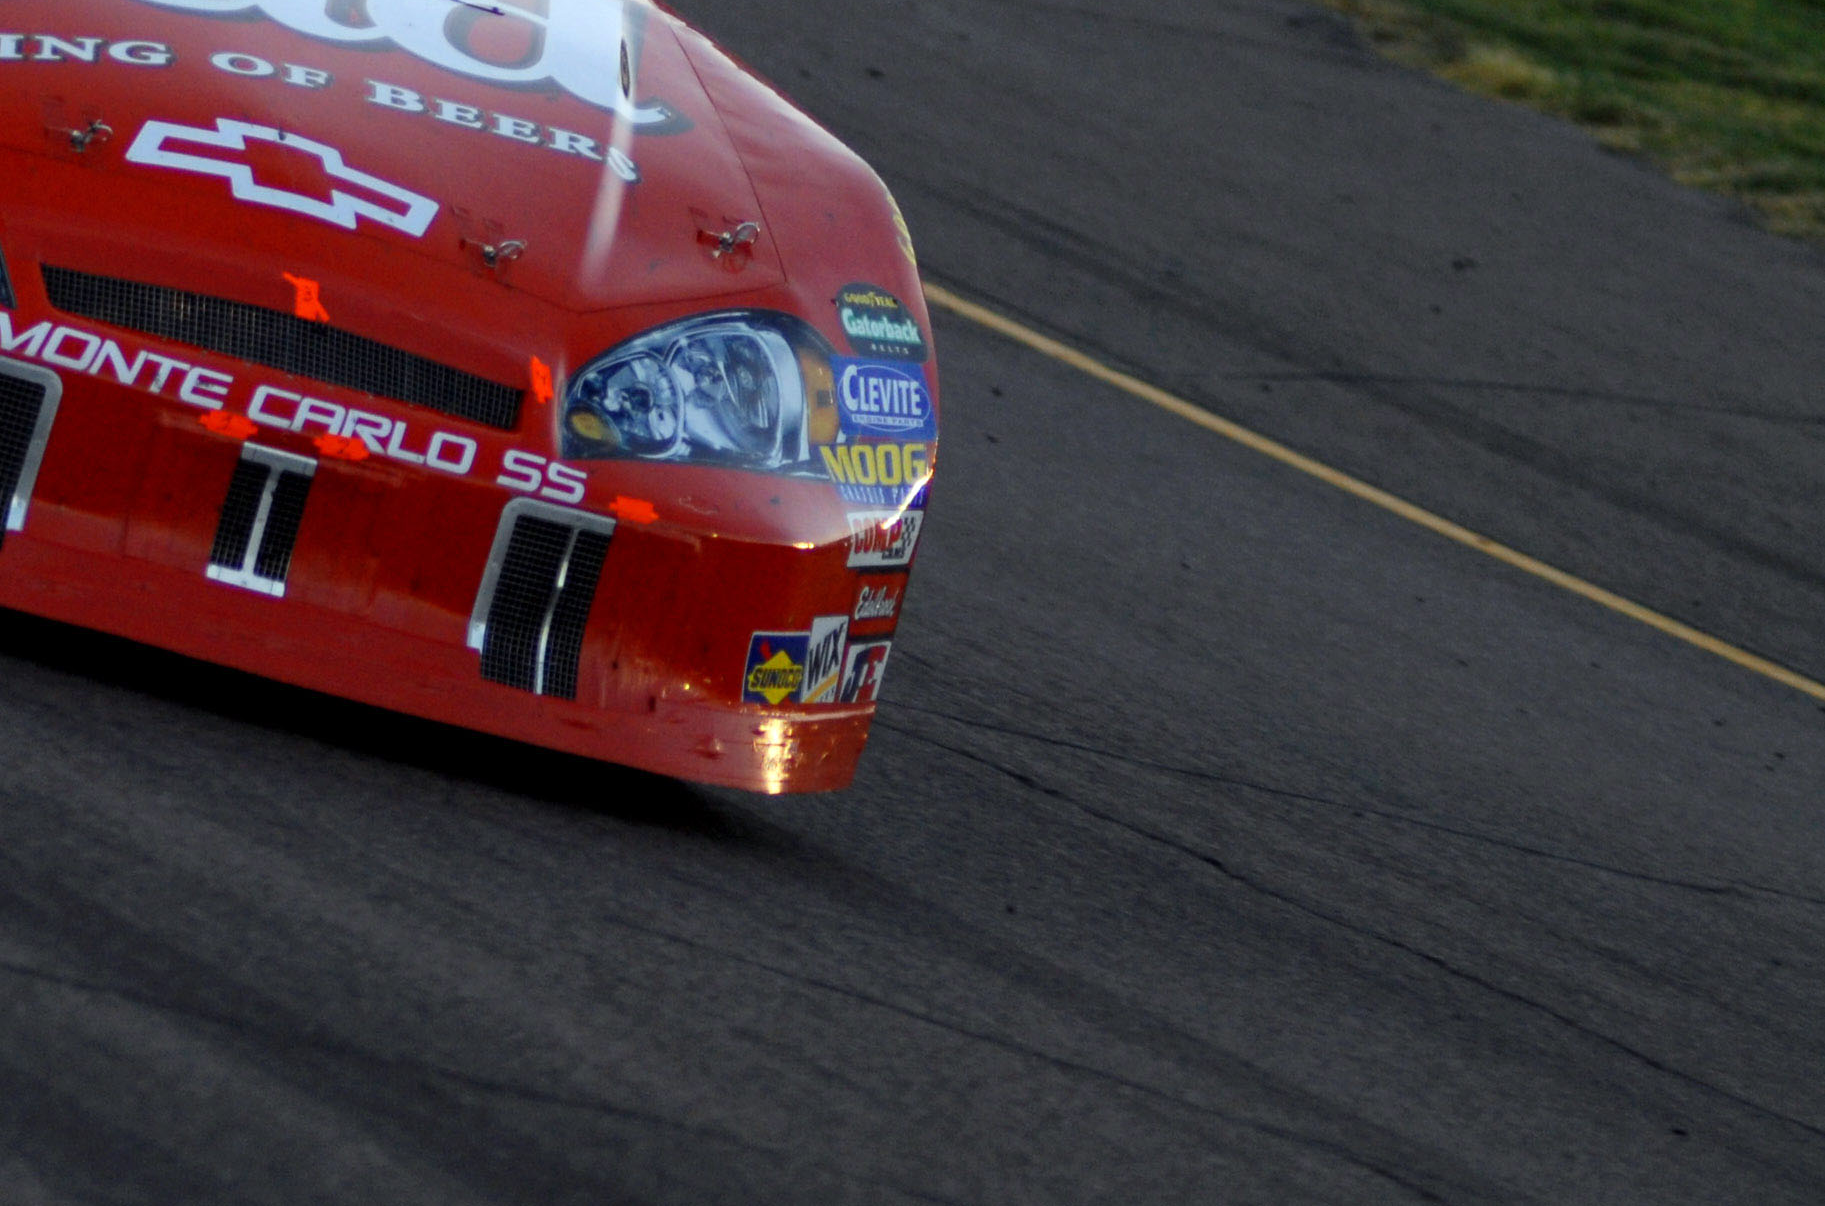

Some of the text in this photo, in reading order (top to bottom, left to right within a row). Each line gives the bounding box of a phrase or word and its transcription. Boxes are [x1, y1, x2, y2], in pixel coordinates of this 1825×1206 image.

[208, 51, 334, 88] OF
[367, 80, 642, 185] BEERS
[841, 307, 922, 345] Gatorback
[841, 364, 923, 416] CLEVITE
[247, 384, 477, 475] CARLO
[496, 449, 588, 504] SS
[819, 443, 926, 486] MOOG
[750, 667, 802, 690] SUNOCO
[807, 620, 848, 691] WIX
